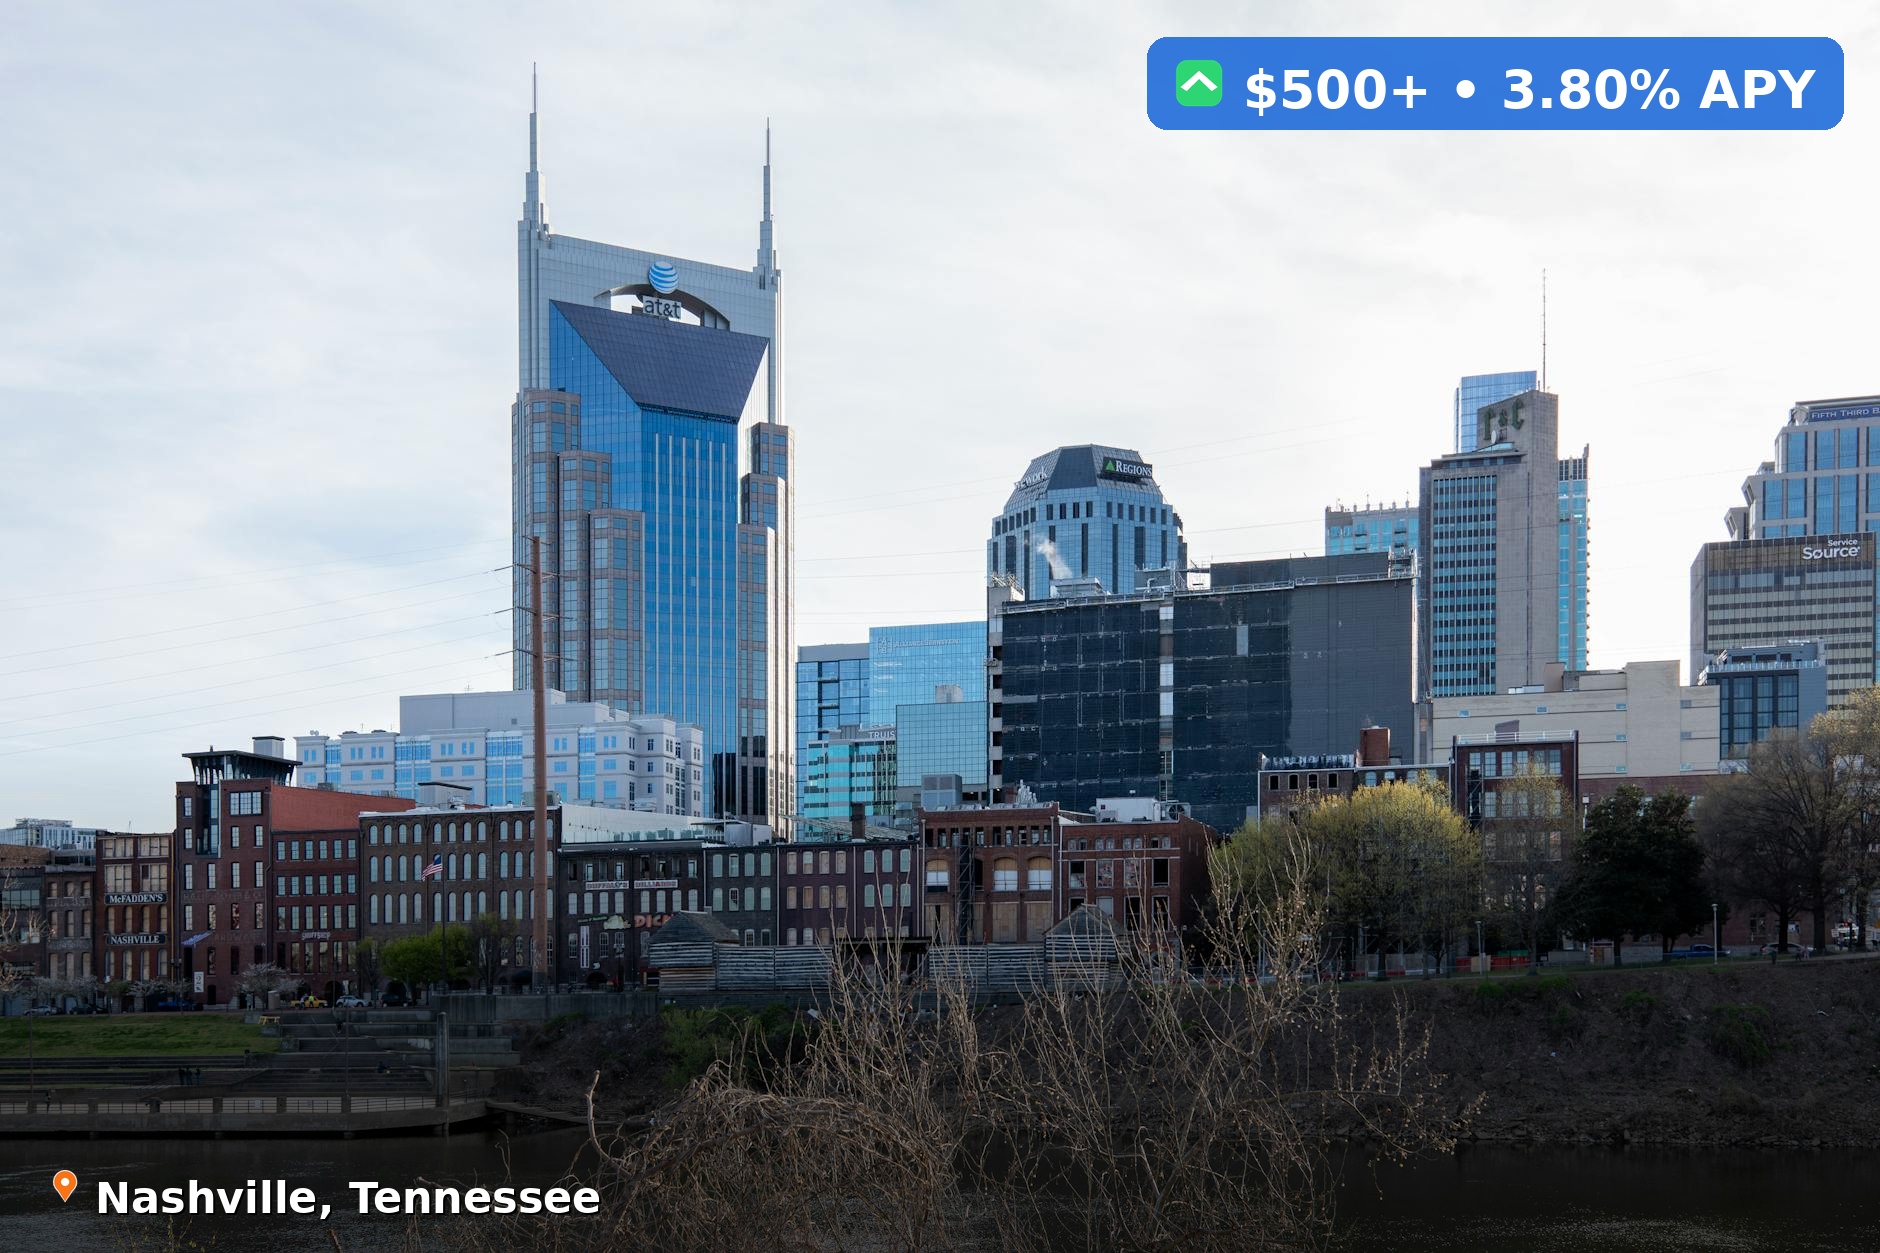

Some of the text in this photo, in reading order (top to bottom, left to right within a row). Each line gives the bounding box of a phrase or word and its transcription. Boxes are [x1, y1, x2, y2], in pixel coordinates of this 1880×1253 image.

[644, 299, 680, 319] at&t
[1811, 411, 1837, 419] FIFTH
[1840, 409, 1870, 417] THIRD
[1116, 460, 1152, 477] REGIONS
[1827, 538, 1858, 547] Service
[1802, 546, 1859, 560] Source
[868, 730, 896, 739] TRUIS
[109, 893, 163, 904] McFADDEN'S
[110, 935, 160, 945] NASHVILLE
